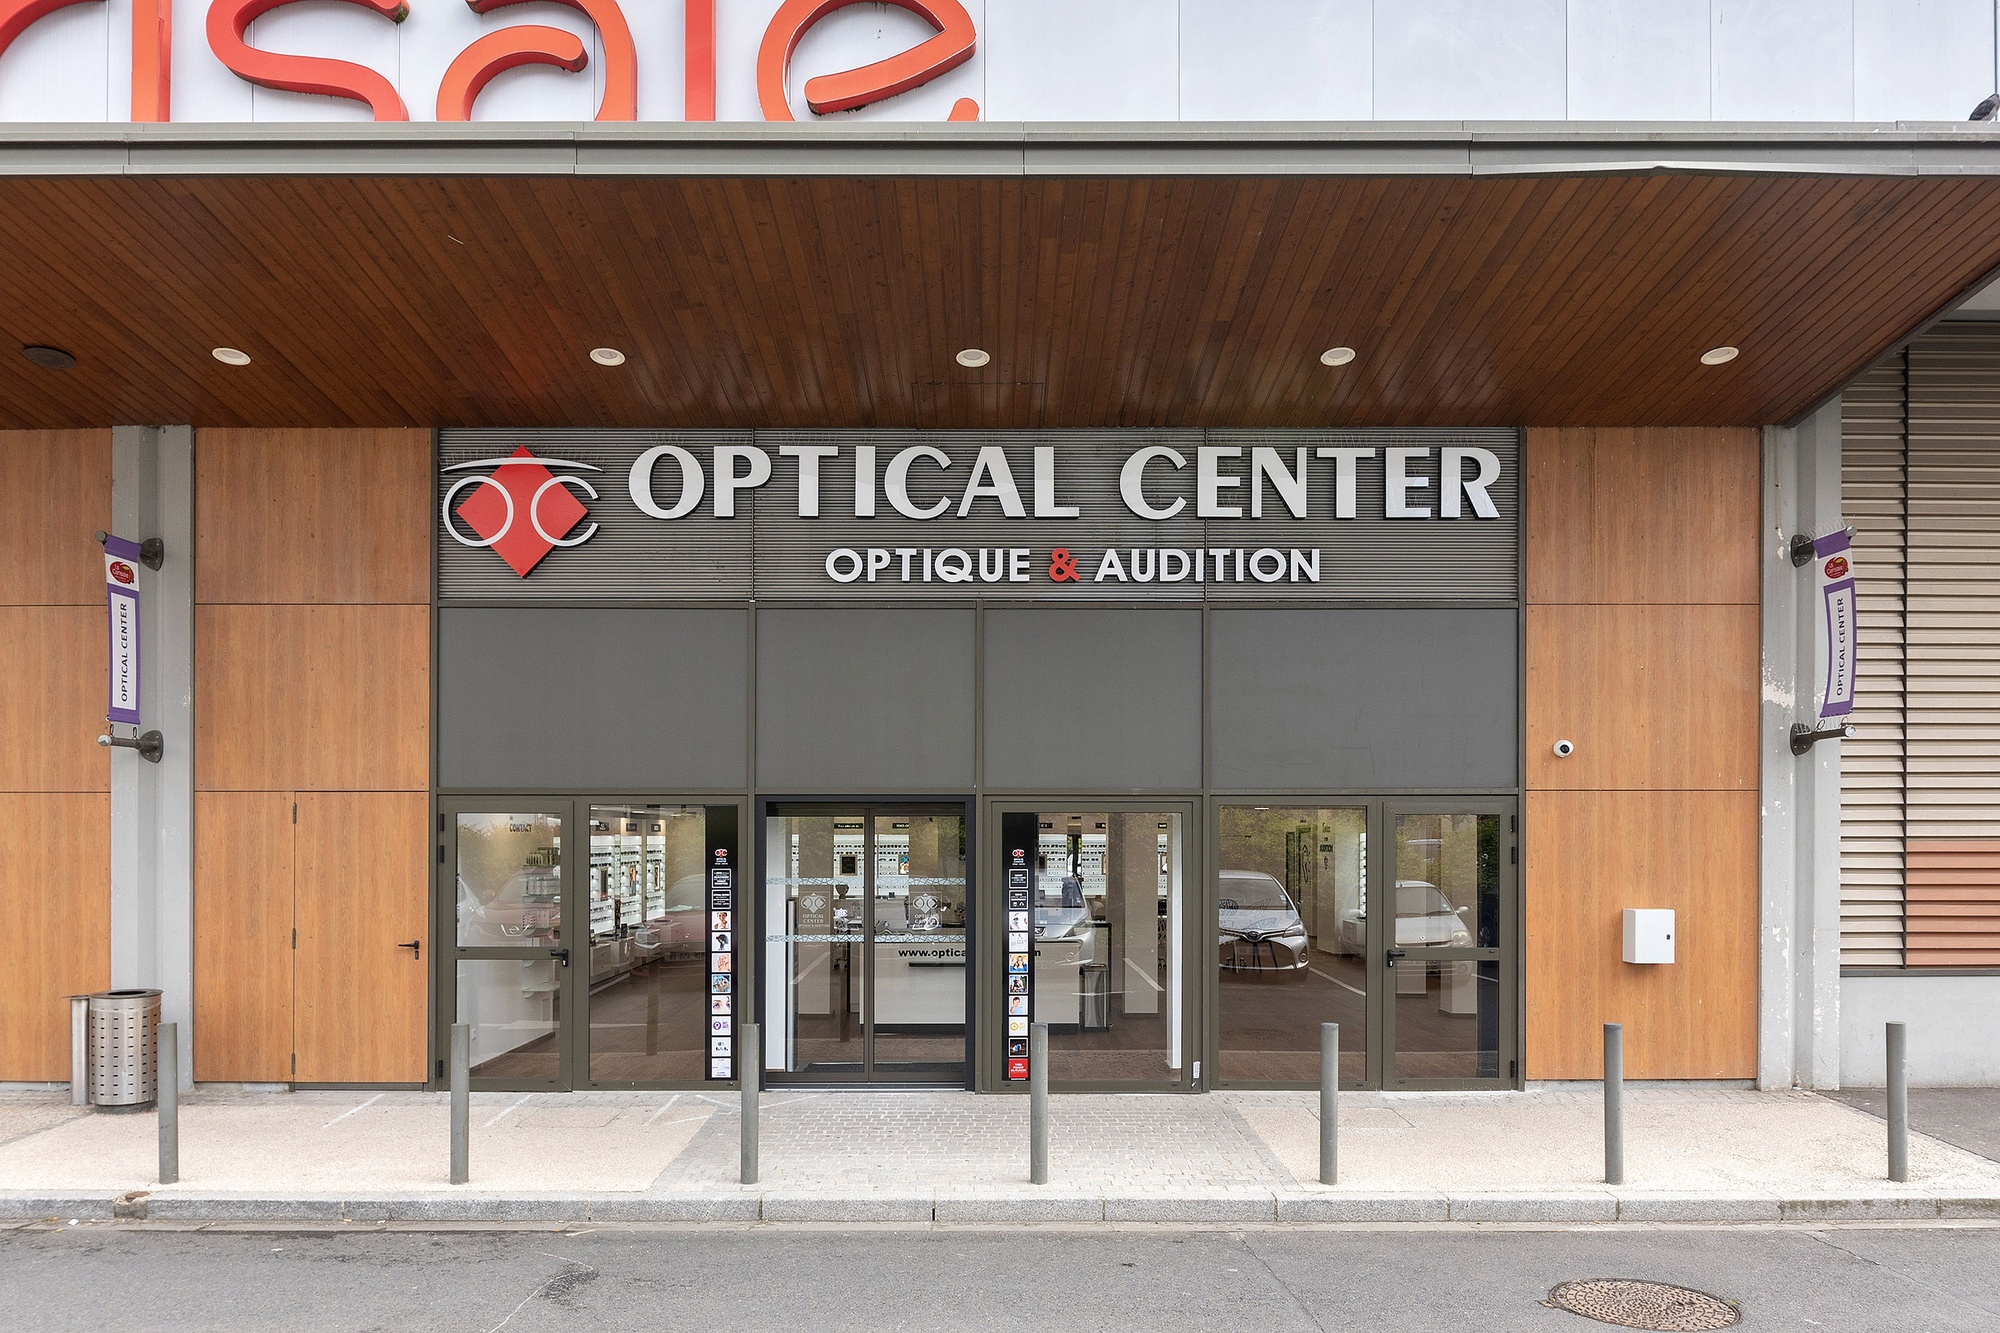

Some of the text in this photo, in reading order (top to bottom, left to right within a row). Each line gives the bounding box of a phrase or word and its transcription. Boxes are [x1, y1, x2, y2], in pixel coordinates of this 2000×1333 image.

[627, 444, 1501, 521] OPTICAL CENTER
[825, 547, 1321, 584] OPTIQUE & AUDITION
[1836, 597, 1845, 696] OPTICAL CENTER
